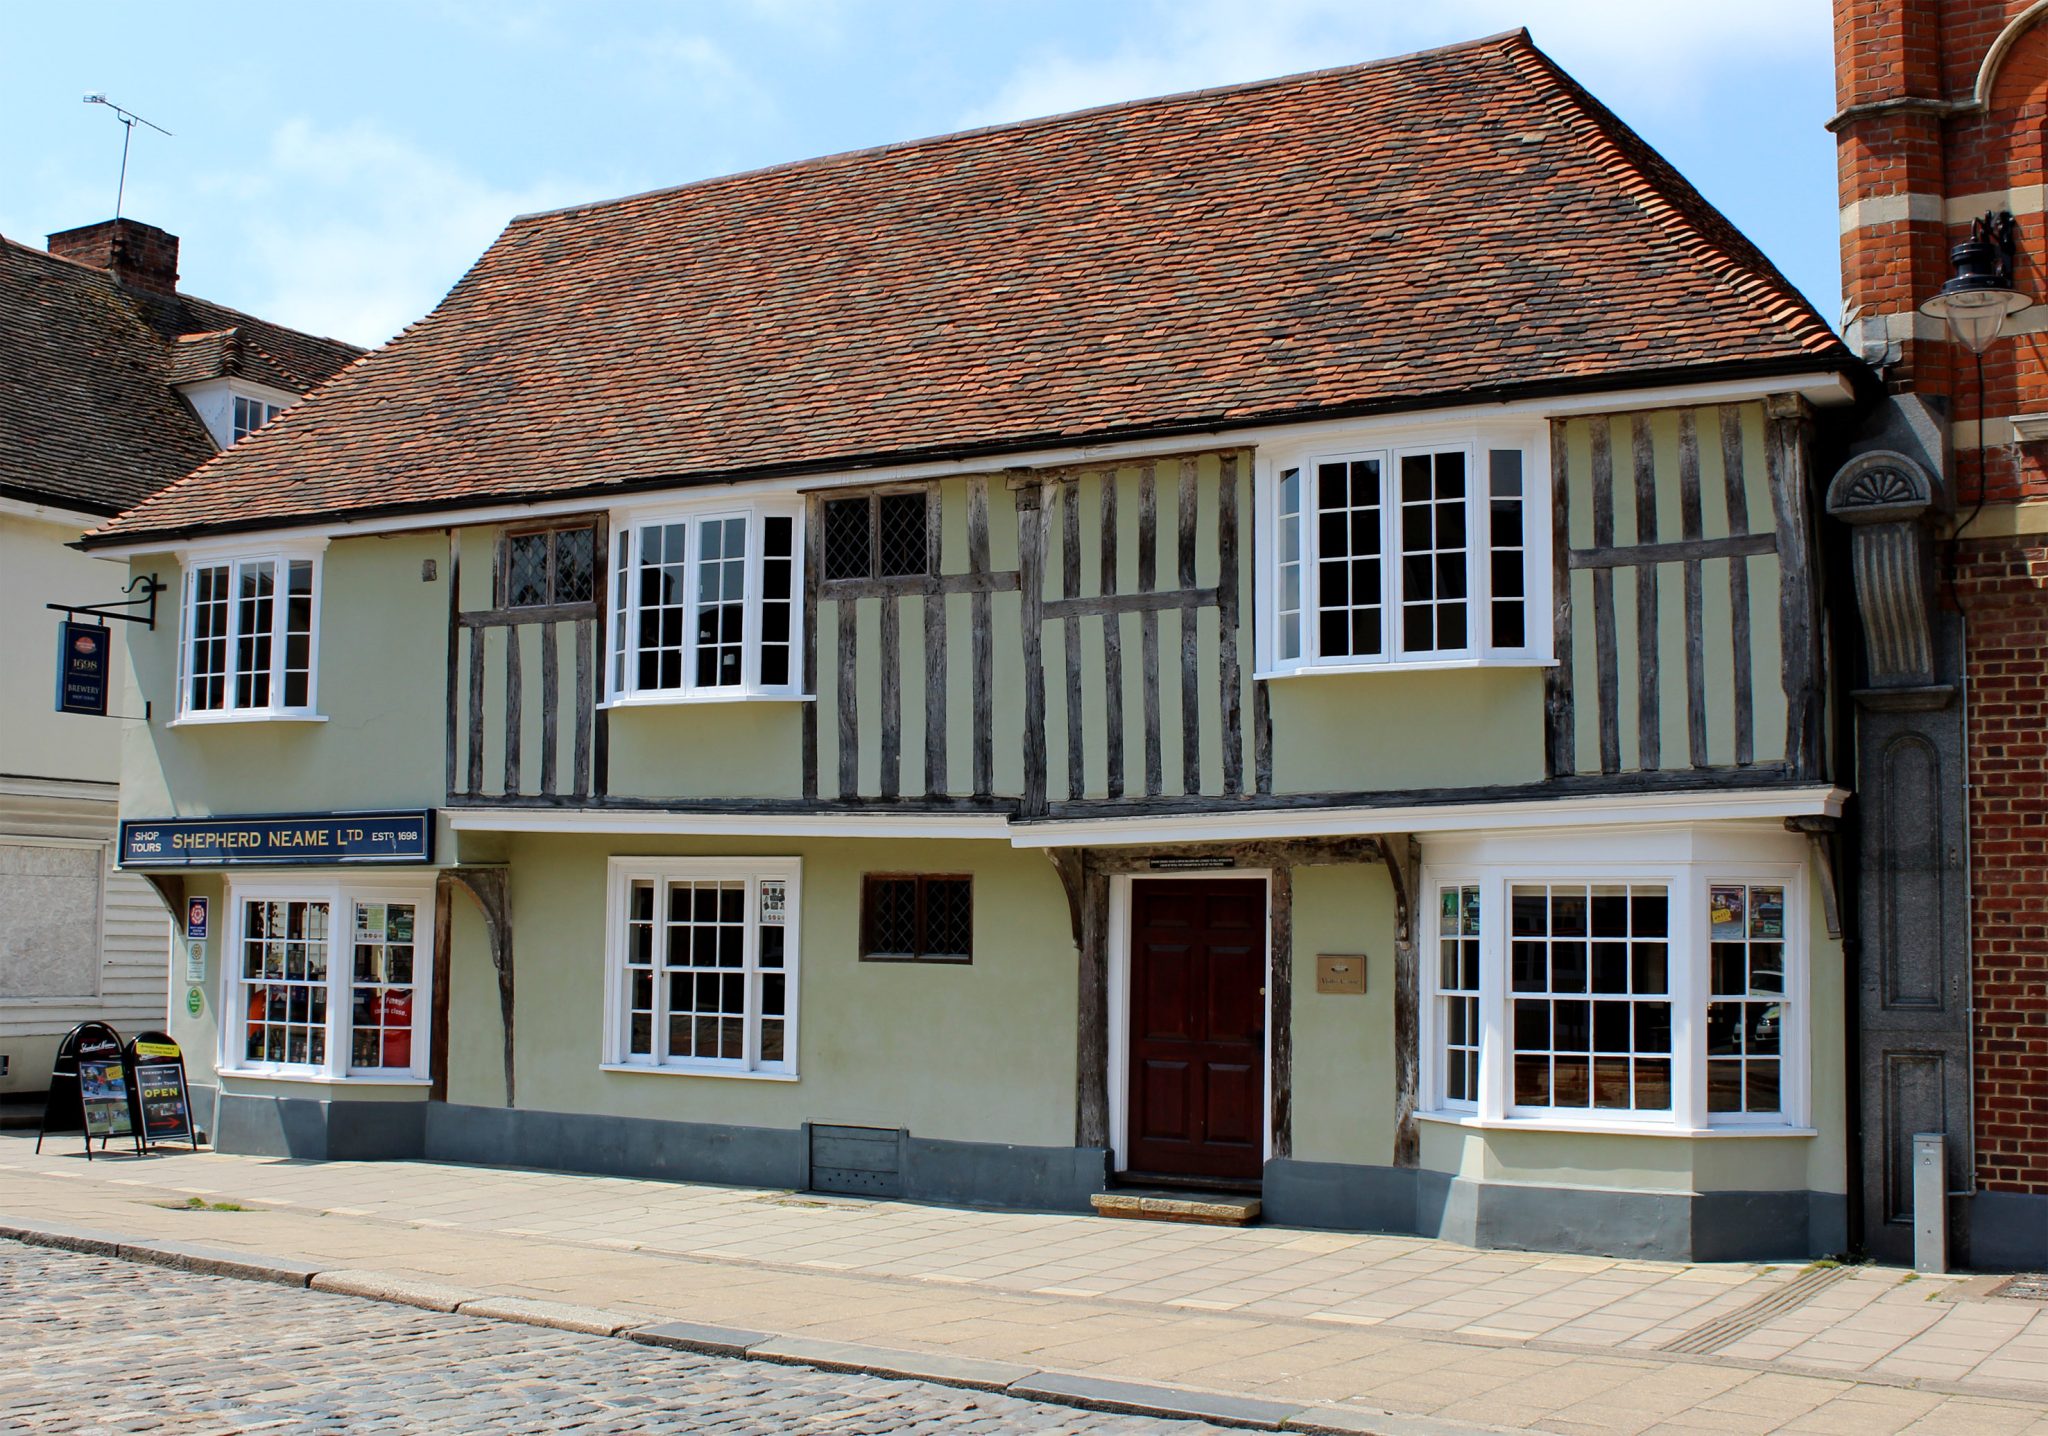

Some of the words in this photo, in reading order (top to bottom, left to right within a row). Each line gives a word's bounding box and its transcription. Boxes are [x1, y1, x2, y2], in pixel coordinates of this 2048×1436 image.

[73, 658, 97, 670] 1698
[68, 684, 99, 695] BREWERY
[134, 831, 159, 841] SHOP
[172, 831, 261, 848] SHEPHERD
[268, 830, 329, 847] NEAME
[397, 831, 418, 841] 1698
[131, 842, 162, 853] TOURS
[144, 1087, 178, 1098] OPEN
